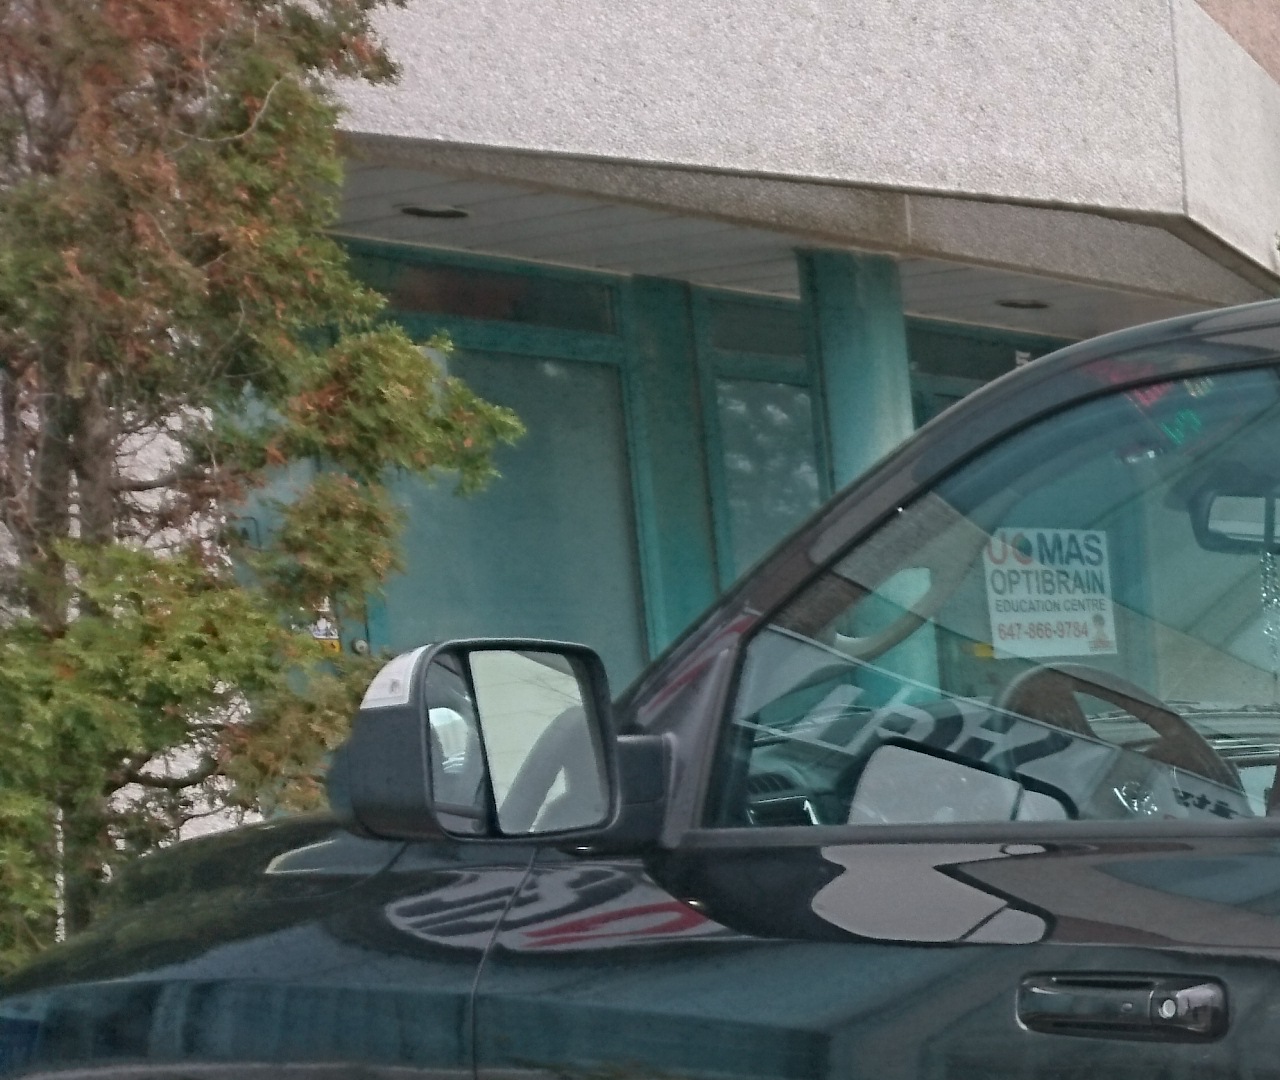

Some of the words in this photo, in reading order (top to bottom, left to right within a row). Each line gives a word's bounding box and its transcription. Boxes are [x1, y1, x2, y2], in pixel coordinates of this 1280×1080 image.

[990, 569, 1105, 595] OPTIBRAIN
[995, 599, 1060, 613] EDUCATION
[1064, 598, 1107, 611] CENTRE
